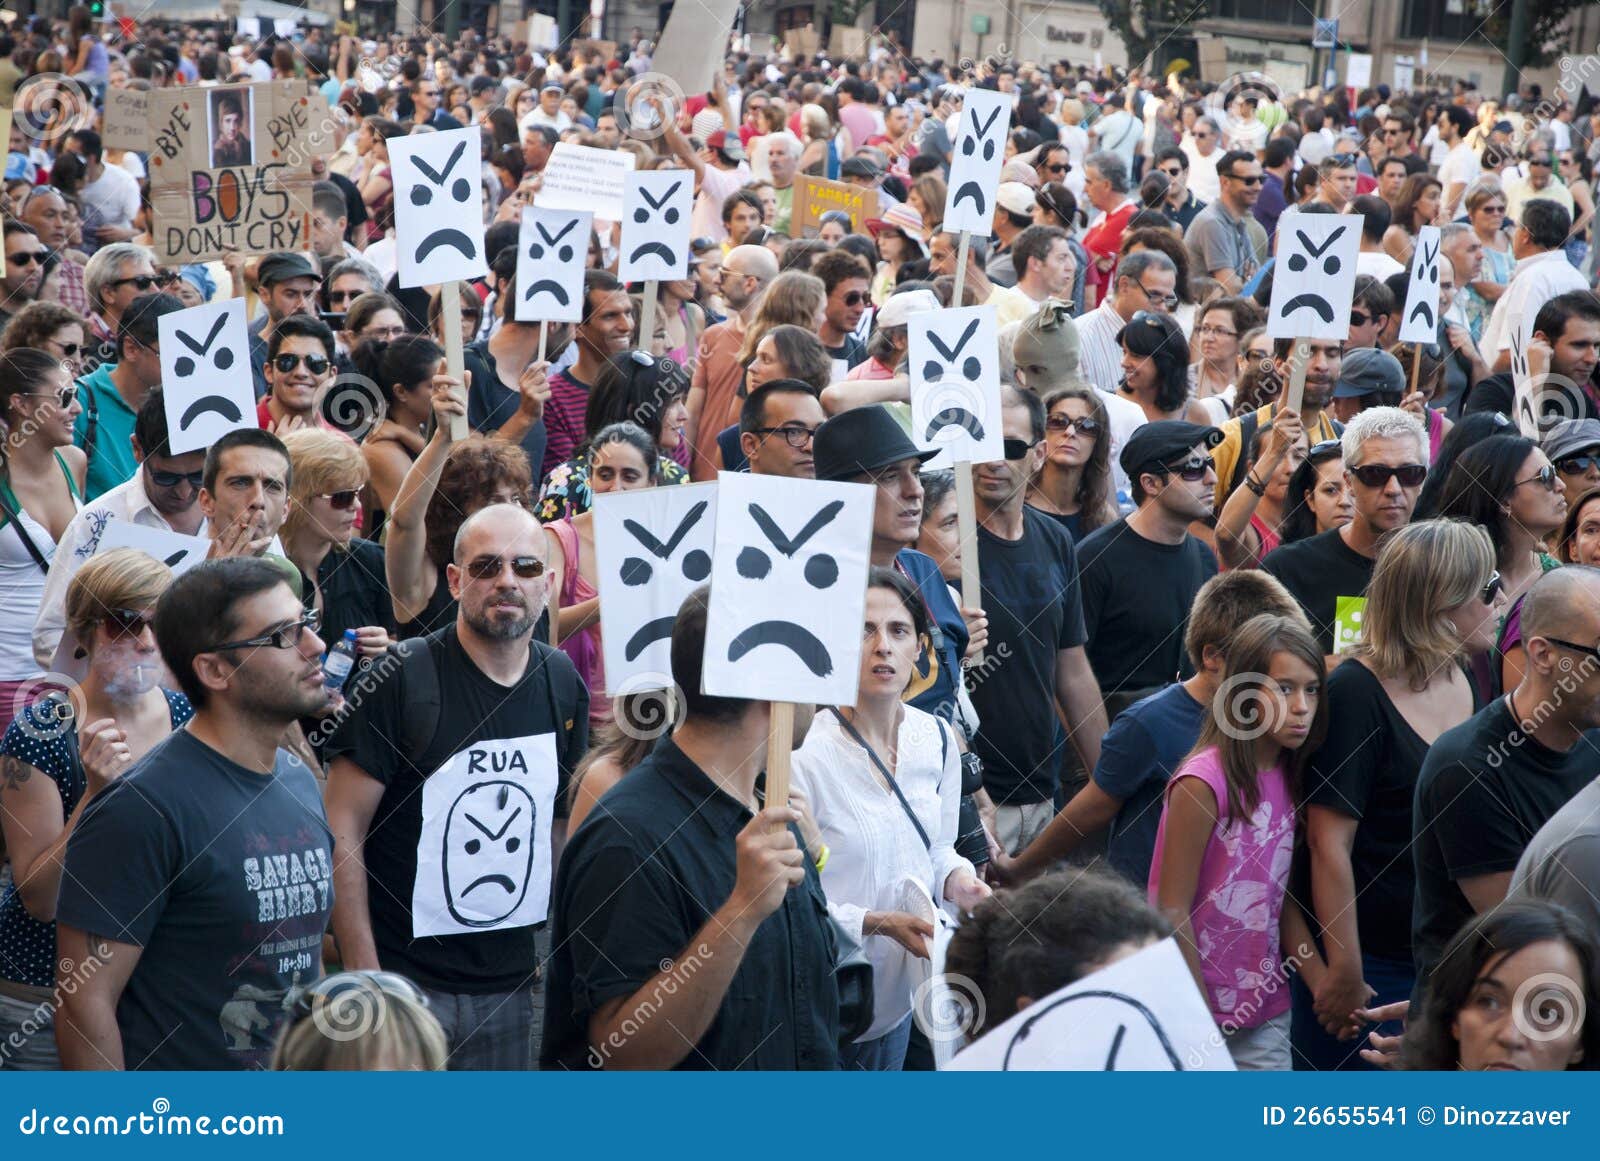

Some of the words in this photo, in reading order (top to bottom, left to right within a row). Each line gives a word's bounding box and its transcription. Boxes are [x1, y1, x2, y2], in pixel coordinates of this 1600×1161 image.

[155, 105, 191, 159] BYE
[266, 101, 307, 151] BYE
[191, 163, 289, 224] BOYS
[247, 211, 310, 251] CRY!
[467, 749, 528, 774] RUA
[257, 880, 329, 922] HENRY
